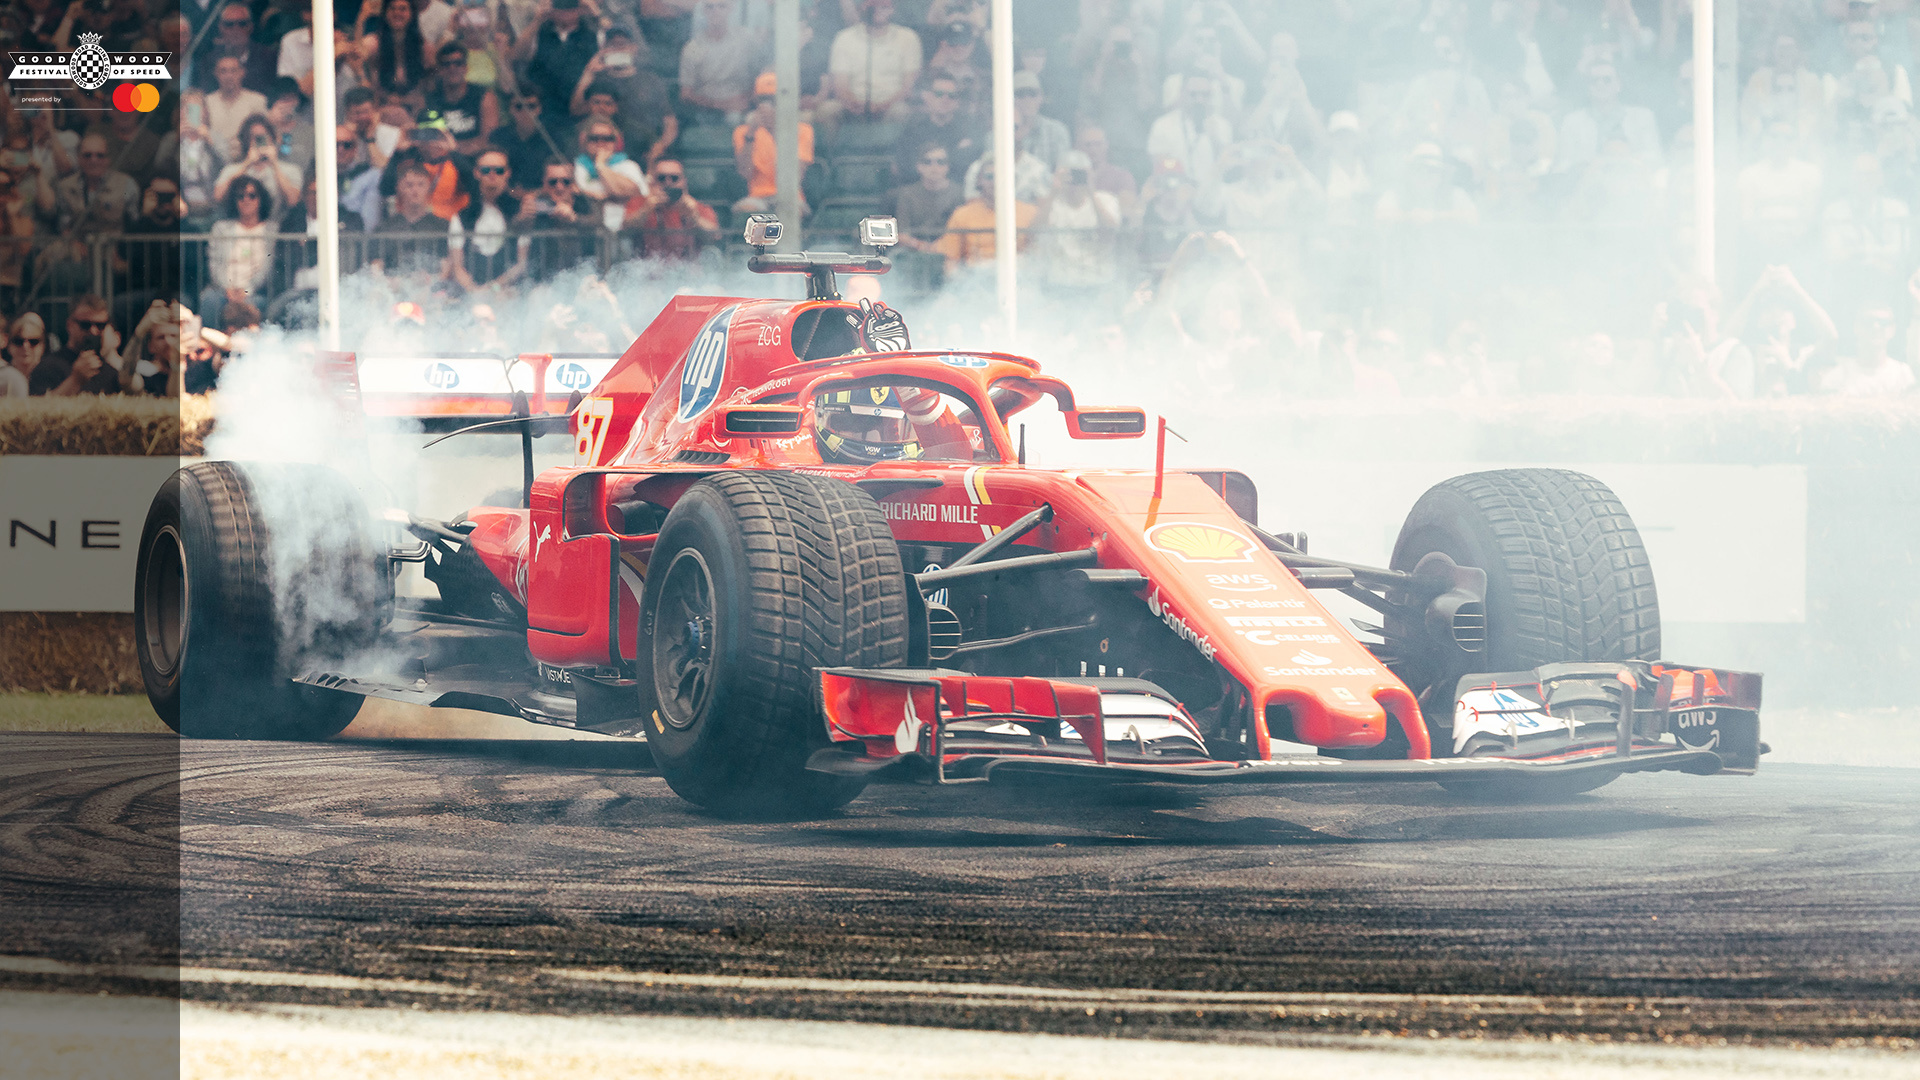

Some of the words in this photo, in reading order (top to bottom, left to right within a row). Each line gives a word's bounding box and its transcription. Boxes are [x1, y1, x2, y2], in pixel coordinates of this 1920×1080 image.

[429, 362, 456, 389] hp
[561, 362, 588, 389] hp
[681, 310, 727, 417] hp
[576, 398, 614, 466] 87
[879, 501, 937, 521] RICHARD
[941, 504, 979, 524] MILLE
[1205, 573, 1270, 584] aws
[1231, 598, 1306, 609] Palantir
[1162, 602, 1218, 663] Santander
[1263, 666, 1377, 676] Santander
